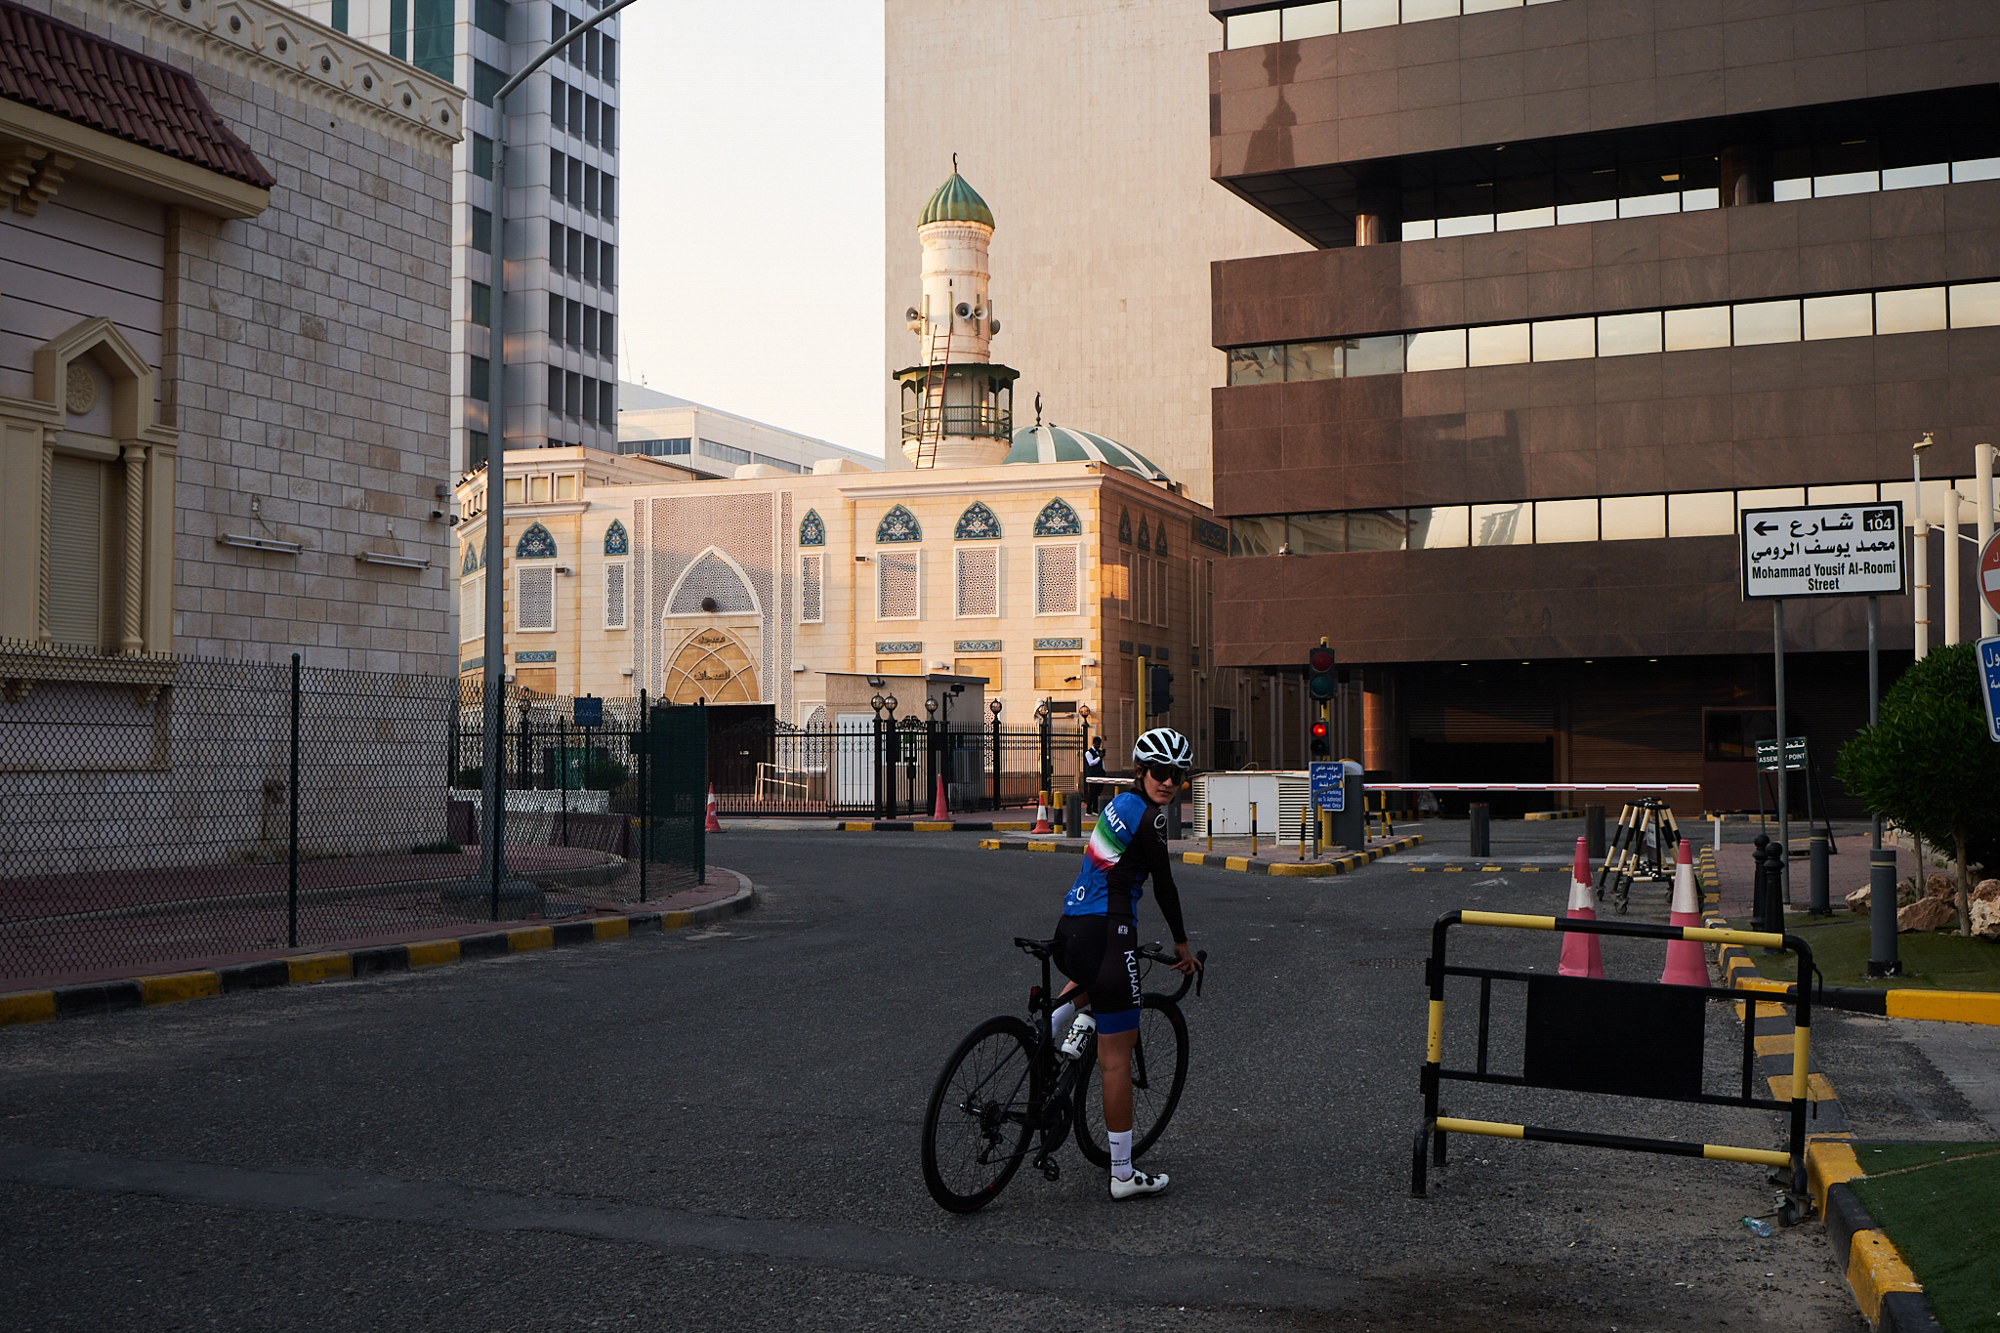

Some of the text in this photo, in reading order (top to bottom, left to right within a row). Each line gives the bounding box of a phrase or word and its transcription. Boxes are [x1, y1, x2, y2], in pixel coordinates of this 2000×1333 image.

[1789, 512, 1854, 537] شارع
[1866, 518, 1892, 530] 104
[1751, 538, 1896, 563] محمد يوسف الرومي
[1752, 560, 1896, 579] Mohammad Yousif Al-Roomi
[1808, 577, 1840, 591] Street
[1785, 740, 1805, 749] نقط
[1788, 752, 1806, 760] POINT
[1123, 950, 1141, 1006] KUWAIT
